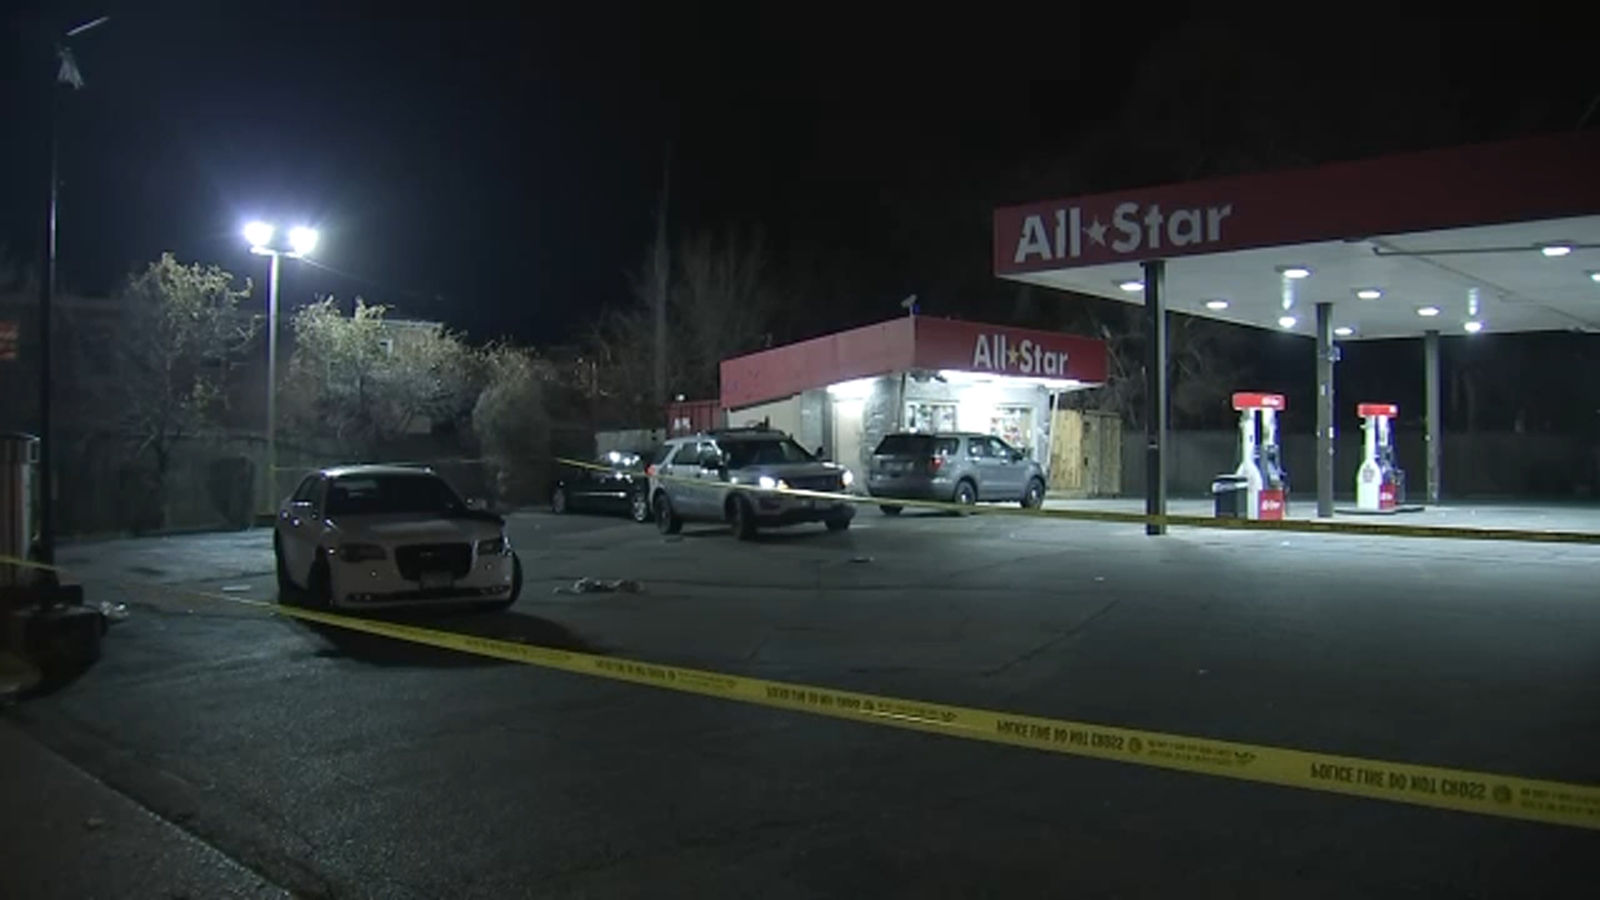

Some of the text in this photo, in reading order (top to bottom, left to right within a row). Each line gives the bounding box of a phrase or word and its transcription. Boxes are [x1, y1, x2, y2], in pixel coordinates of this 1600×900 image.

[1014, 202, 1232, 263] All Star
[974, 334, 1068, 376] All Star
